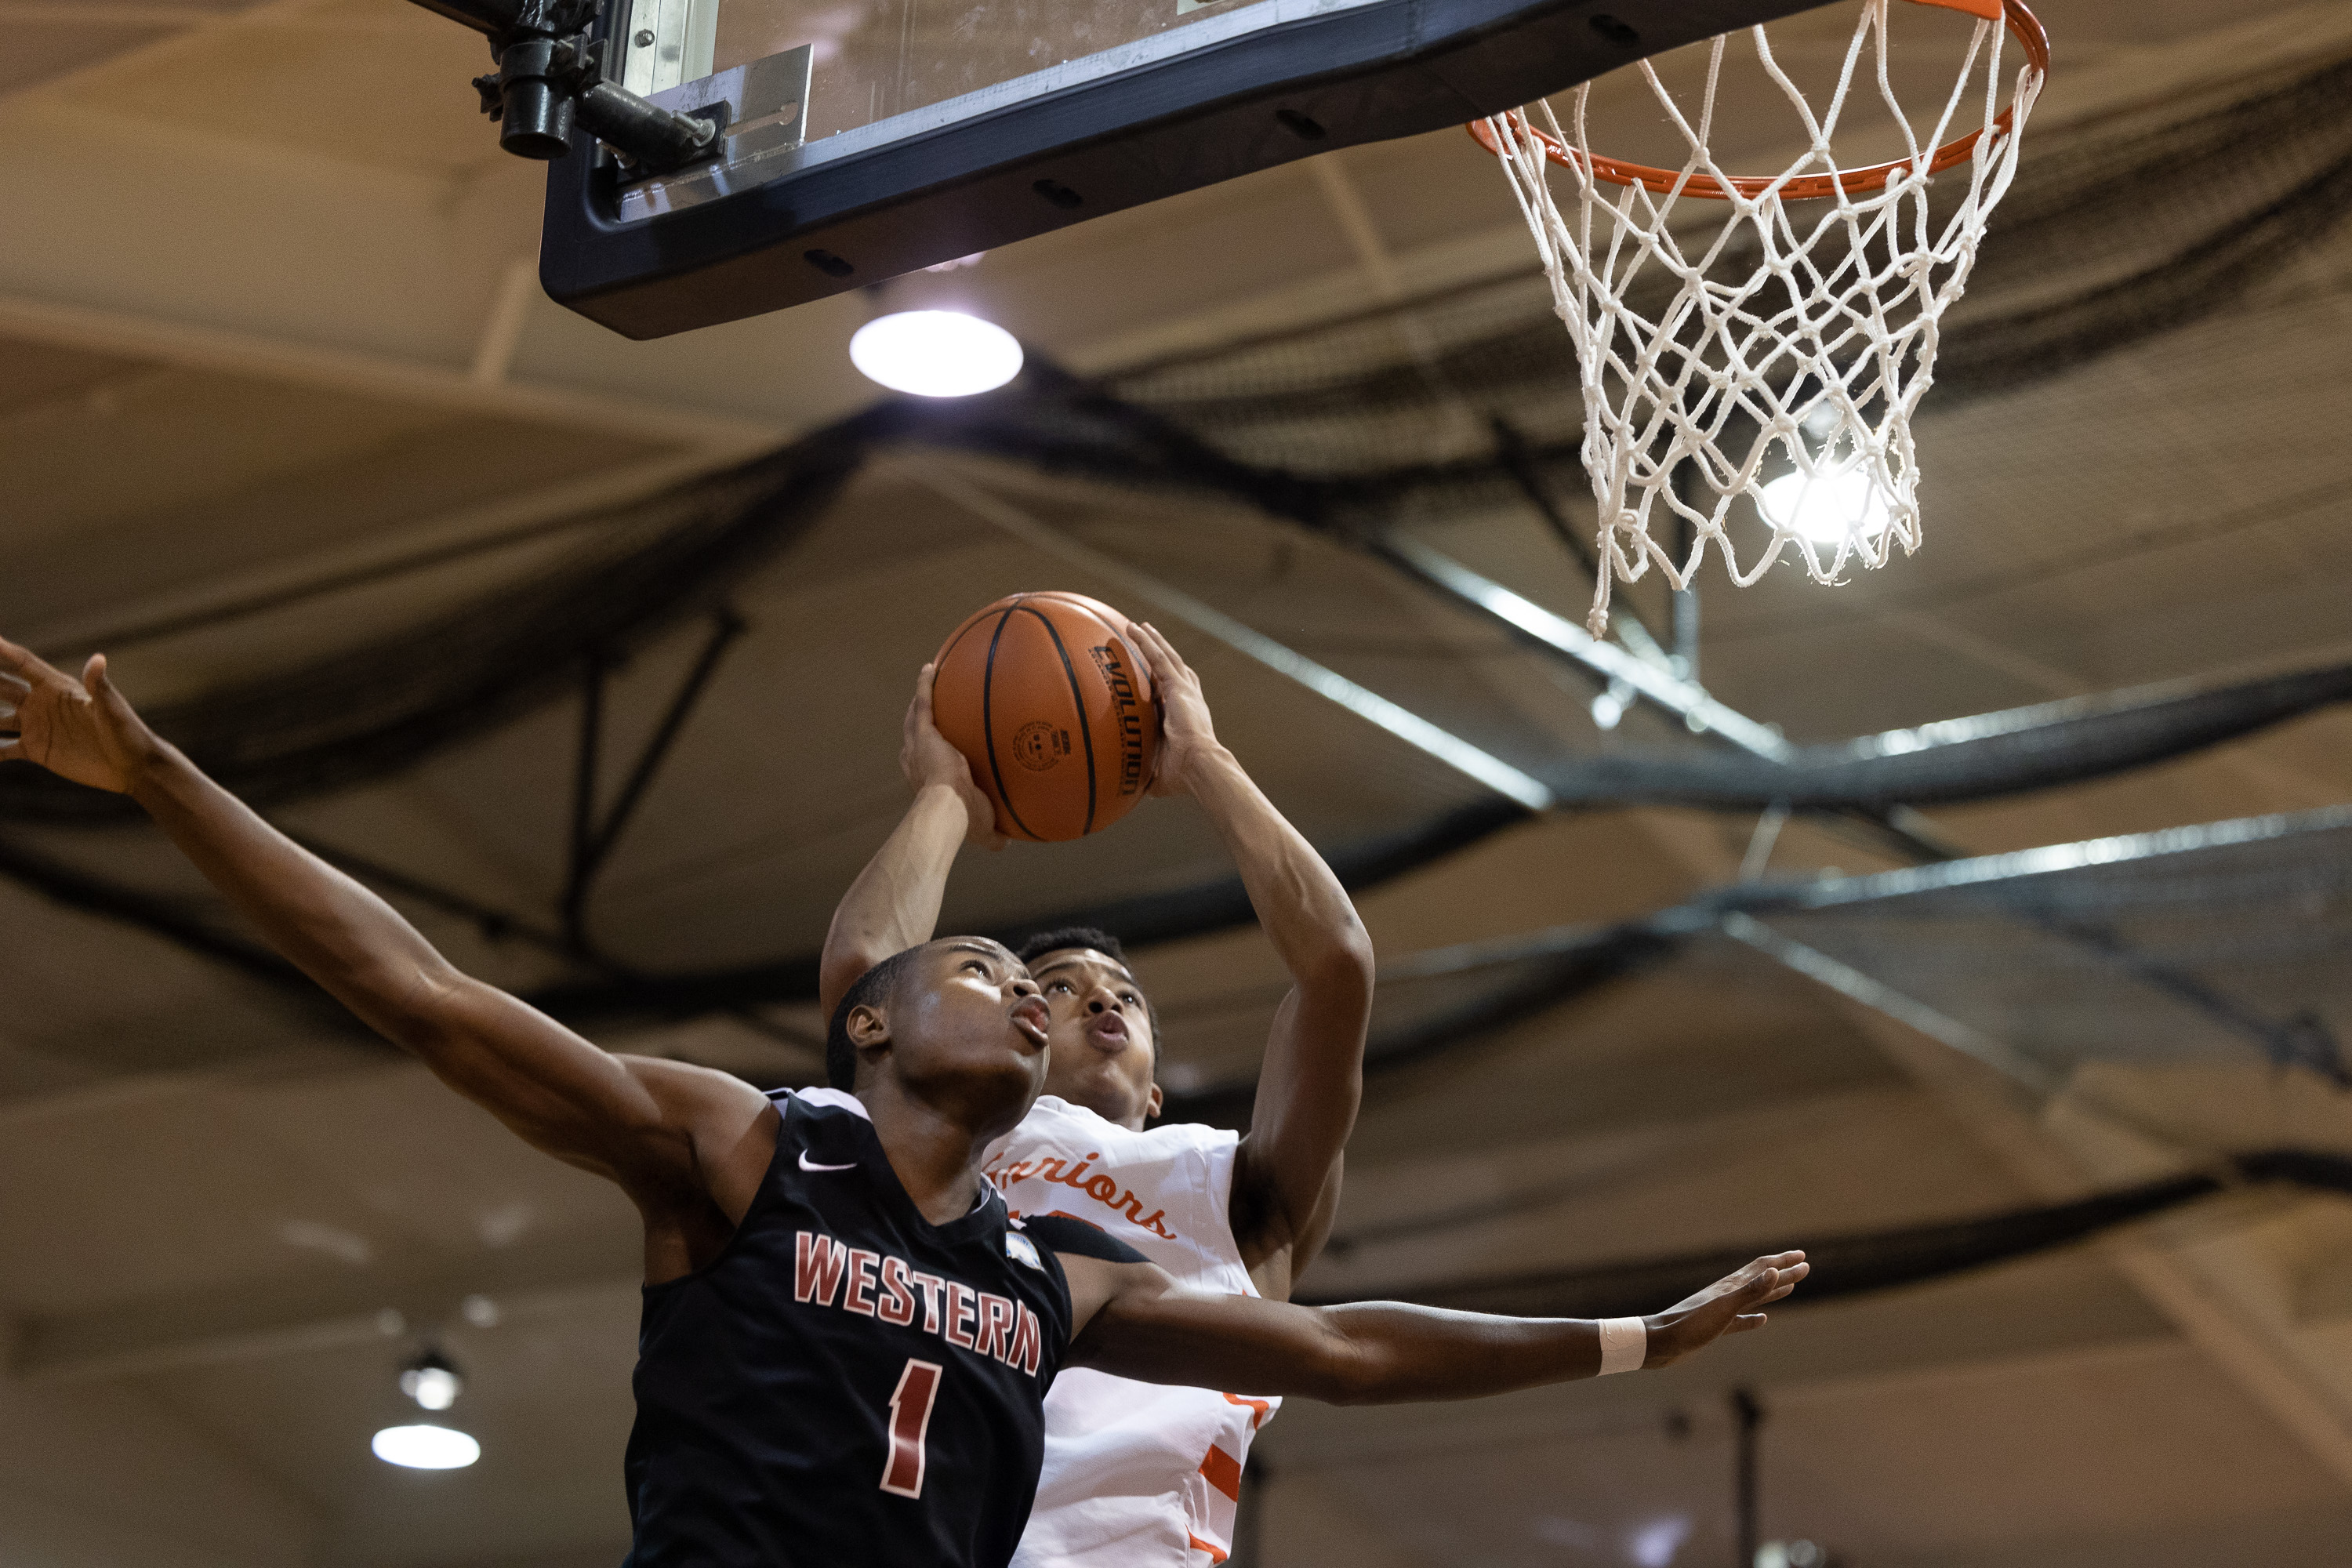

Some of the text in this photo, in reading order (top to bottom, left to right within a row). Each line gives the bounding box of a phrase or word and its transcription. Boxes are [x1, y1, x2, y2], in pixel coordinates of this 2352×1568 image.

[1094, 646, 1142, 795] EVOLUTION
[794, 1231, 1041, 1377] WESTERN
[879, 1358, 943, 1500] 1
